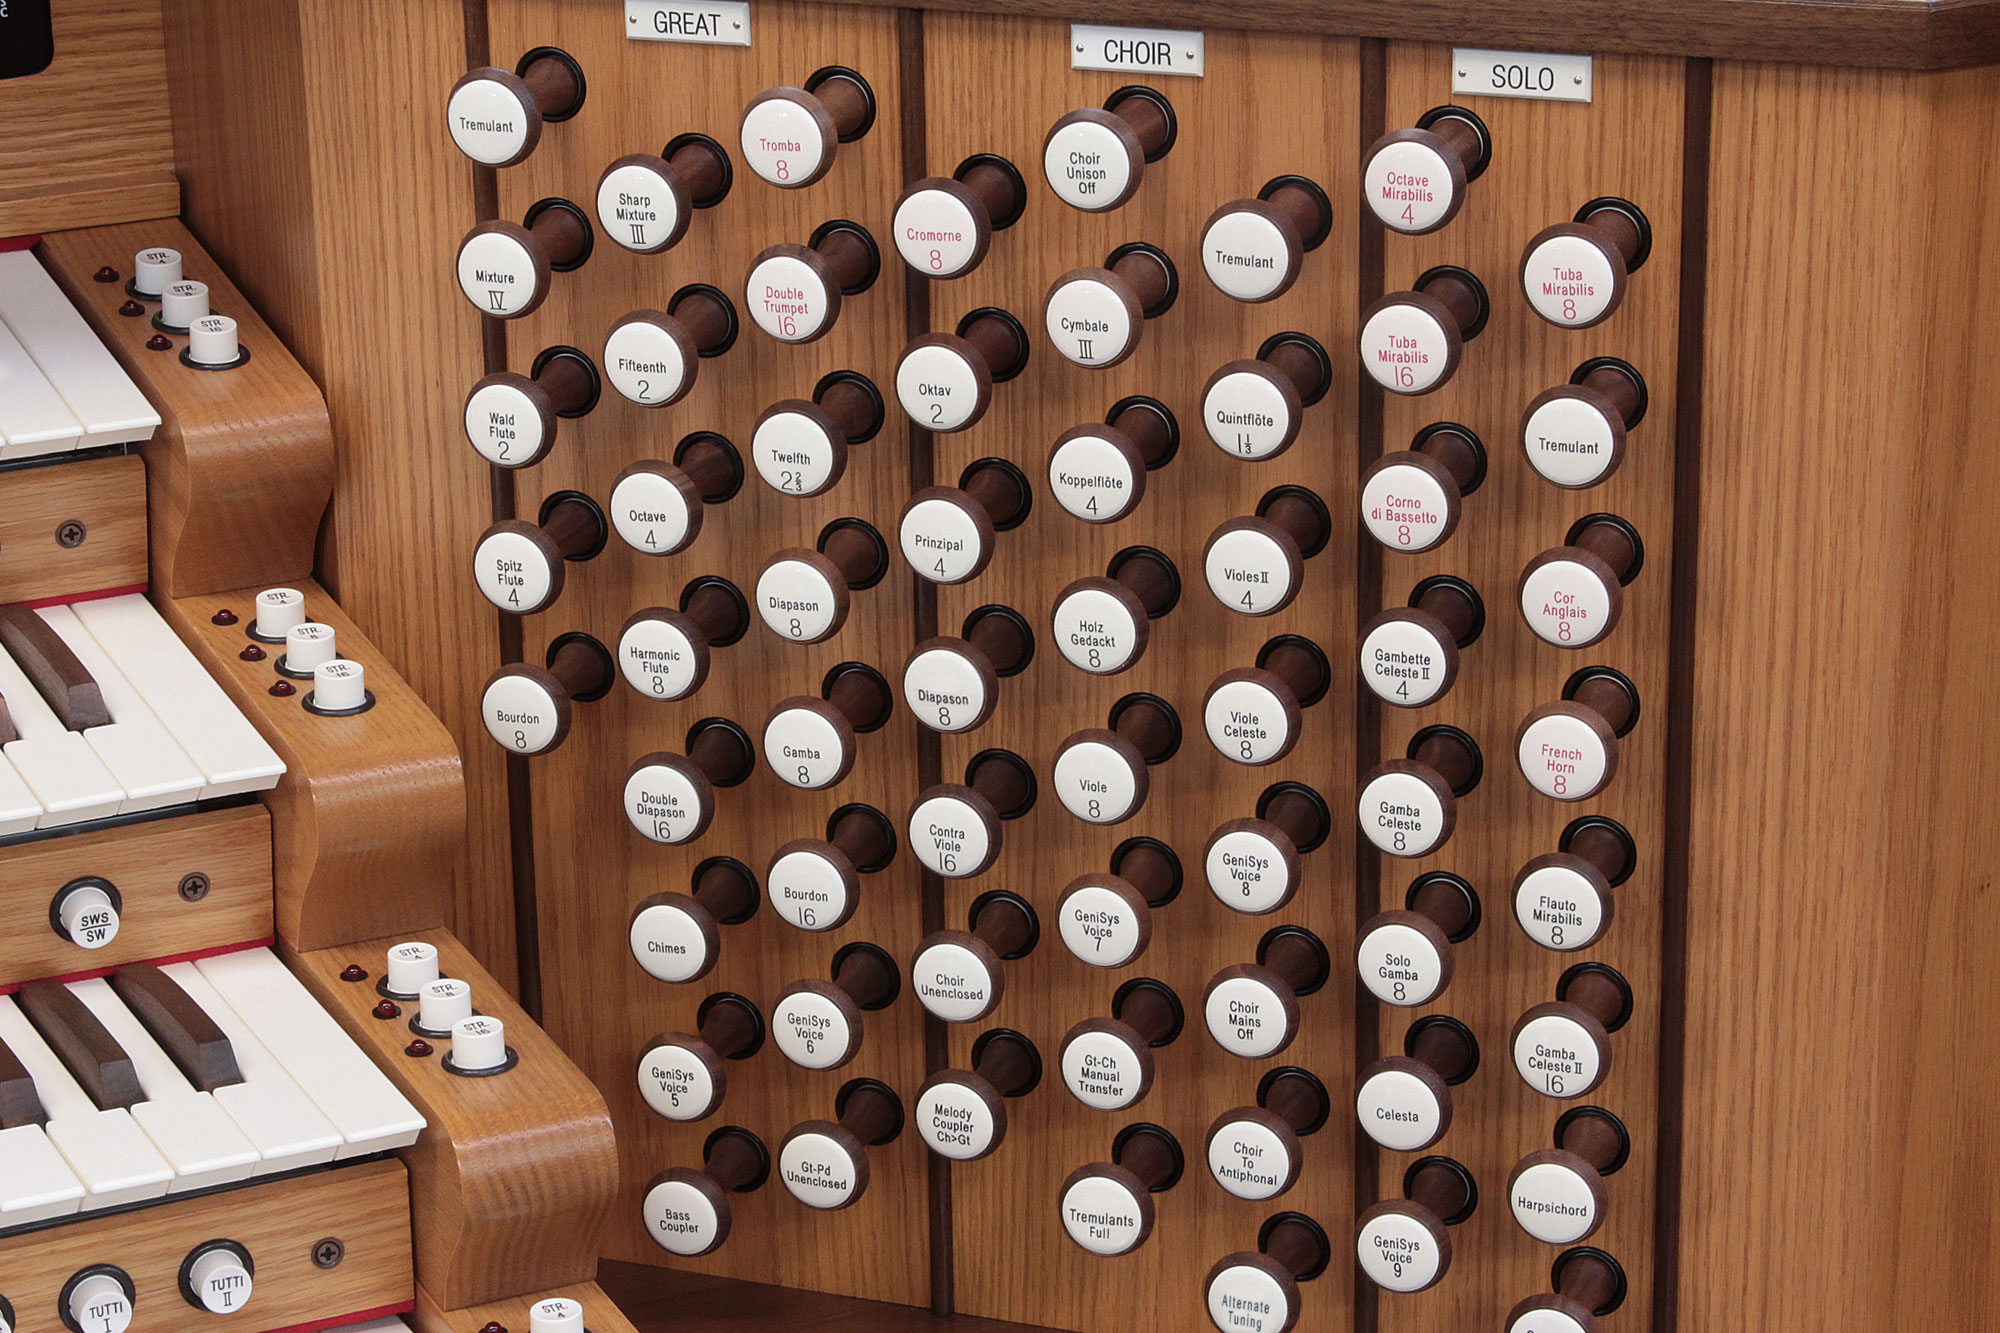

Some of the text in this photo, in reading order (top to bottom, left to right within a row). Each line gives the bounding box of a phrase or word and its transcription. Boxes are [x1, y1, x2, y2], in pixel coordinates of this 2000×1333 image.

[654, 10, 721, 36] GREAT
[1104, 39, 1171, 65] CHOIR
[1492, 64, 1554, 91] SOLO
[459, 117, 513, 132] Tremulant
[760, 139, 800, 151] Tromba
[1070, 152, 1100, 165] Choir
[1067, 167, 1106, 179] Unison
[1387, 172, 1428, 187] Octave
[1079, 182, 1095, 194] Off
[1383, 186, 1433, 202] Mirabilis
[619, 193, 650, 208] Sharp
[616, 208, 655, 221] Mixture
[1401, 204, 1414, 225] 4
[907, 228, 961, 241] Cromorne
[930, 250, 942, 270] 8
[1216, 250, 1273, 269] Tremulant
[476, 270, 514, 284] Mixture
[1553, 268, 1582, 281] Tuba
[766, 286, 803, 300] Double
[1543, 283, 1594, 296] Mirabilis
[764, 300, 808, 316] Trumpet
[1563, 299, 1576, 320] 8
[778, 316, 798, 337] 16
[1061, 318, 1108, 333] Cymbale
[1388, 336, 1416, 348] Tuba
[1379, 350, 1428, 363] Mirabilis
[619, 359, 666, 373] Fifteenth
[1394, 367, 1416, 389] 16
[638, 380, 650, 400] 2
[919, 384, 951, 396] Oktav
[489, 412, 514, 425] Wald
[931, 404, 944, 424] 2
[490, 426, 515, 439] Flute
[498, 441, 511, 460] 2
[1539, 438, 1598, 454] Tremulant
[772, 450, 810, 465] Twelfth
[1086, 496, 1098, 515] 4
[1387, 495, 1420, 508] Corno
[630, 510, 666, 522] Octave
[1372, 508, 1437, 523] di Bassetto
[645, 530, 657, 549] 4
[1399, 525, 1410, 545] 8
[916, 535, 963, 552] Prinzipal
[497, 560, 522, 575] Spitz
[934, 558, 945, 577] 4
[498, 572, 524, 586] Flute
[1225, 568, 1268, 583] Violes II
[508, 588, 519, 607] 4
[770, 597, 818, 612] Diapason
[1241, 590, 1253, 610] 4
[1554, 591, 1575, 604] Cor
[1543, 604, 1586, 620] Anglais
[1080, 621, 1103, 633] Holz
[1071, 634, 1115, 647] Gedackt
[631, 647, 680, 661] Harmonic
[1375, 649, 1430, 666] Gambette
[643, 661, 669, 674] Flute
[1375, 663, 1430, 680] Celeste II
[653, 676, 664, 694] 8
[1396, 681, 1409, 700] 4
[918, 689, 968, 705] Diapason
[497, 710, 539, 724] Bourdon
[1231, 711, 1258, 725] Viole
[515, 730, 526, 749] 8
[1224, 725, 1266, 739] Celeste
[783, 746, 820, 759] Gamba
[1542, 744, 1581, 760] French
[1547, 759, 1574, 773] Horn
[1080, 779, 1107, 793] Viole
[1552, 775, 1568, 795] 8
[642, 792, 677, 806] Double
[637, 802, 685, 818] Diapason
[1379, 801, 1420, 818] Gamba
[1378, 814, 1421, 831] Celeste
[652, 821, 673, 841] 16
[930, 824, 964, 841] Contra
[934, 838, 961, 852] Viole
[938, 854, 957, 874] 16
[1223, 853, 1268, 871] GeniSys
[1231, 868, 1260, 881] Voice
[785, 887, 828, 901] Bourdon
[1242, 882, 1250, 896] 8
[1540, 896, 1576, 911] Flauto
[81, 912, 109, 927] SWS
[799, 907, 815, 926] 16
[1075, 909, 1119, 927] GeniSys
[1533, 908, 1582, 926] Mirabilis
[87, 928, 106, 942] SW
[1083, 922, 1112, 939] Voice
[1549, 926, 1563, 945] 8
[648, 941, 686, 954] Chimes
[1094, 937, 1101, 952] 7
[1386, 954, 1410, 967] Solo
[936, 974, 964, 986] Choir
[1379, 967, 1418, 981] Gamba
[921, 984, 983, 1000] Unenclosed
[1230, 1001, 1259, 1014] Choir
[788, 1013, 830, 1029] GeniSys
[1229, 1014, 1261, 1027] Mains
[795, 1027, 823, 1040] Voice
[1237, 1028, 1253, 1040] Off
[807, 1040, 814, 1054] 6
[1536, 1045, 1575, 1060] Gamba
[1085, 1055, 1116, 1069] Gt-Ch
[1529, 1055, 1582, 1074] Celeste II
[652, 1067, 694, 1084] GeniSys
[1079, 1065, 1119, 1084] Manual
[659, 1079, 688, 1093] Voice
[1078, 1080, 1123, 1096] Transfer
[1546, 1073, 1564, 1095] 16
[672, 1093, 679, 1107] 5
[933, 1104, 972, 1123] Melody
[1377, 1108, 1419, 1122] Celesta
[933, 1116, 974, 1135] Coupler
[1234, 1142, 1263, 1159] Choir
[801, 1161, 830, 1176] Gt-Pd
[1242, 1157, 1254, 1169] To
[787, 1172, 846, 1192] Unenclosed
[1219, 1165, 1277, 1187] Antiphonal
[1518, 1196, 1586, 1216] Harpsichord
[666, 1209, 690, 1221] Bass
[1070, 1208, 1134, 1229] Tremulants
[660, 1220, 698, 1234] Coupler
[1090, 1226, 1109, 1239] Full
[1374, 1235, 1420, 1254] GeniSys
[1382, 1250, 1412, 1263] Voice
[1394, 1263, 1401, 1278] 9
[211, 1275, 244, 1292] TUTTI
[223, 1292, 233, 1307] II
[1222, 1294, 1269, 1316] Alternate
[89, 1302, 123, 1319] TUTTI
[1228, 1310, 1263, 1332] Tuning
